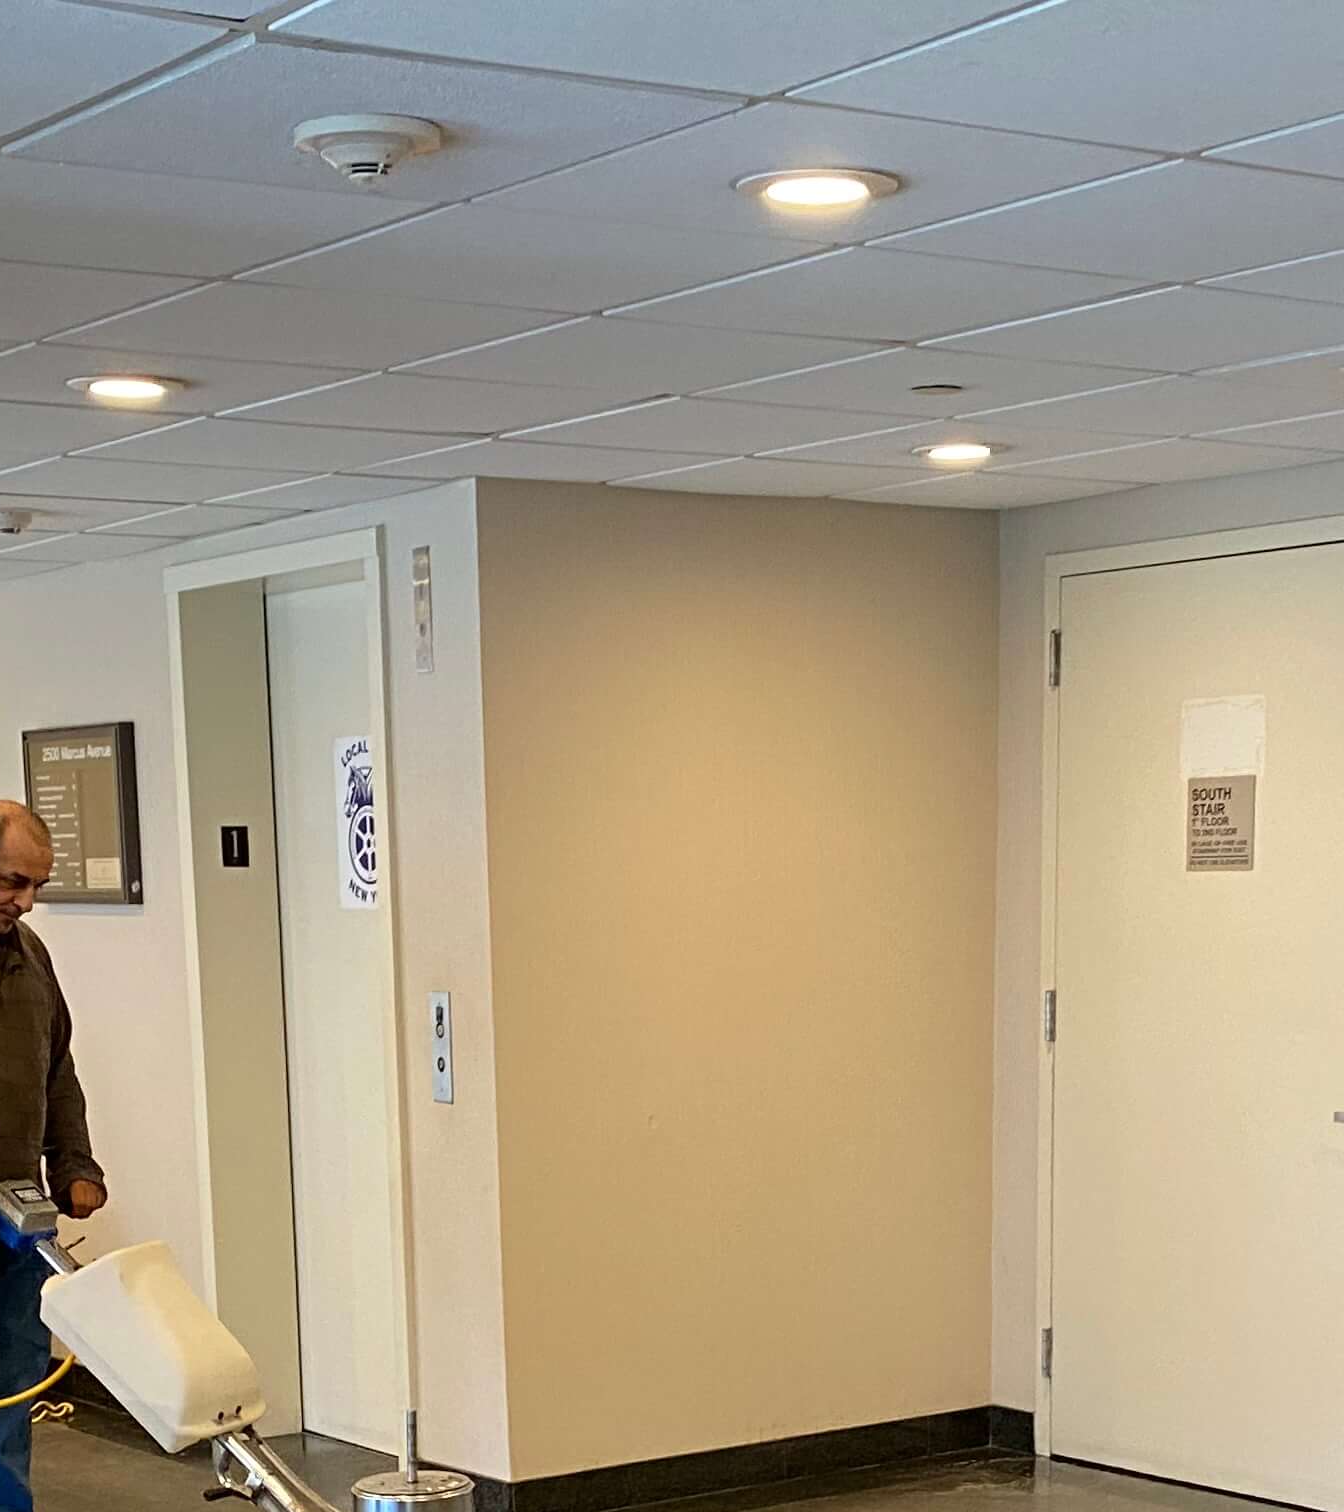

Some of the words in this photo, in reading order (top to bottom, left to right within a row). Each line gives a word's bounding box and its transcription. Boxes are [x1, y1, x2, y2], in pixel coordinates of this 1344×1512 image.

[341, 740, 369, 767] LOCAL
[1191, 787, 1232, 801] SOUTH
[1192, 803, 1225, 816] STAIR
[1201, 816, 1229, 826] FLOOR
[230, 830, 239, 858] 1
[348, 878, 369, 903] NEW
